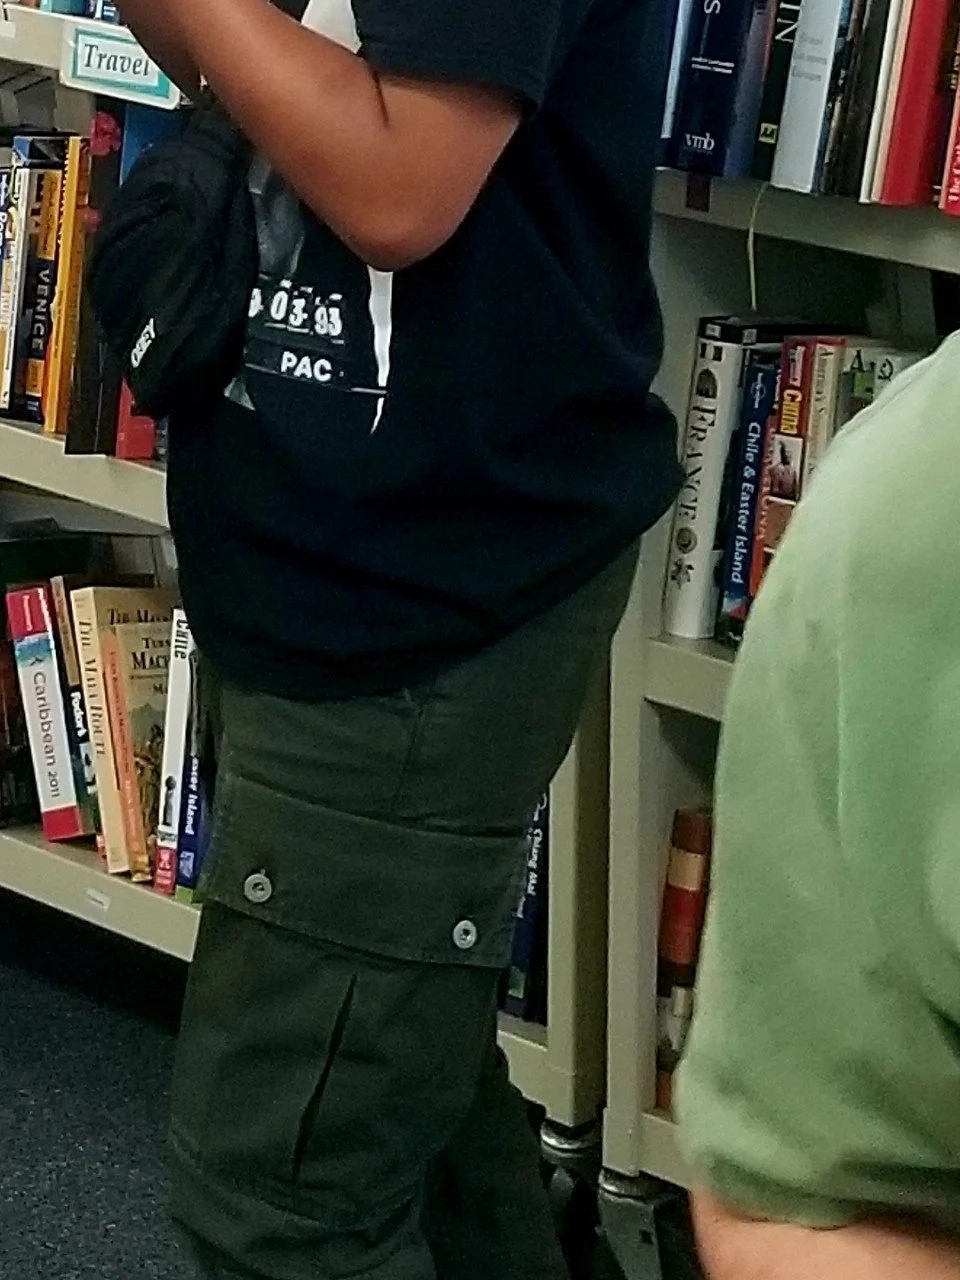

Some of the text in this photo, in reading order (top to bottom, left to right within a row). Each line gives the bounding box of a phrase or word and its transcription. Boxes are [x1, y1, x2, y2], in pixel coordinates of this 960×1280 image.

[84, 43, 150, 77] Travel
[685, 133, 716, 151] vmb
[31, 268, 51, 356] VENICE
[280, 350, 333, 382] PAC
[678, 403, 717, 521] FRANCE
[744, 422, 761, 462] Chile
[743, 465, 756, 480] &
[736, 483, 754, 533] Easter
[731, 535, 748, 585] Island
[32, 670, 62, 800] Caribbean 2011
[184, 794, 199, 836] Island
